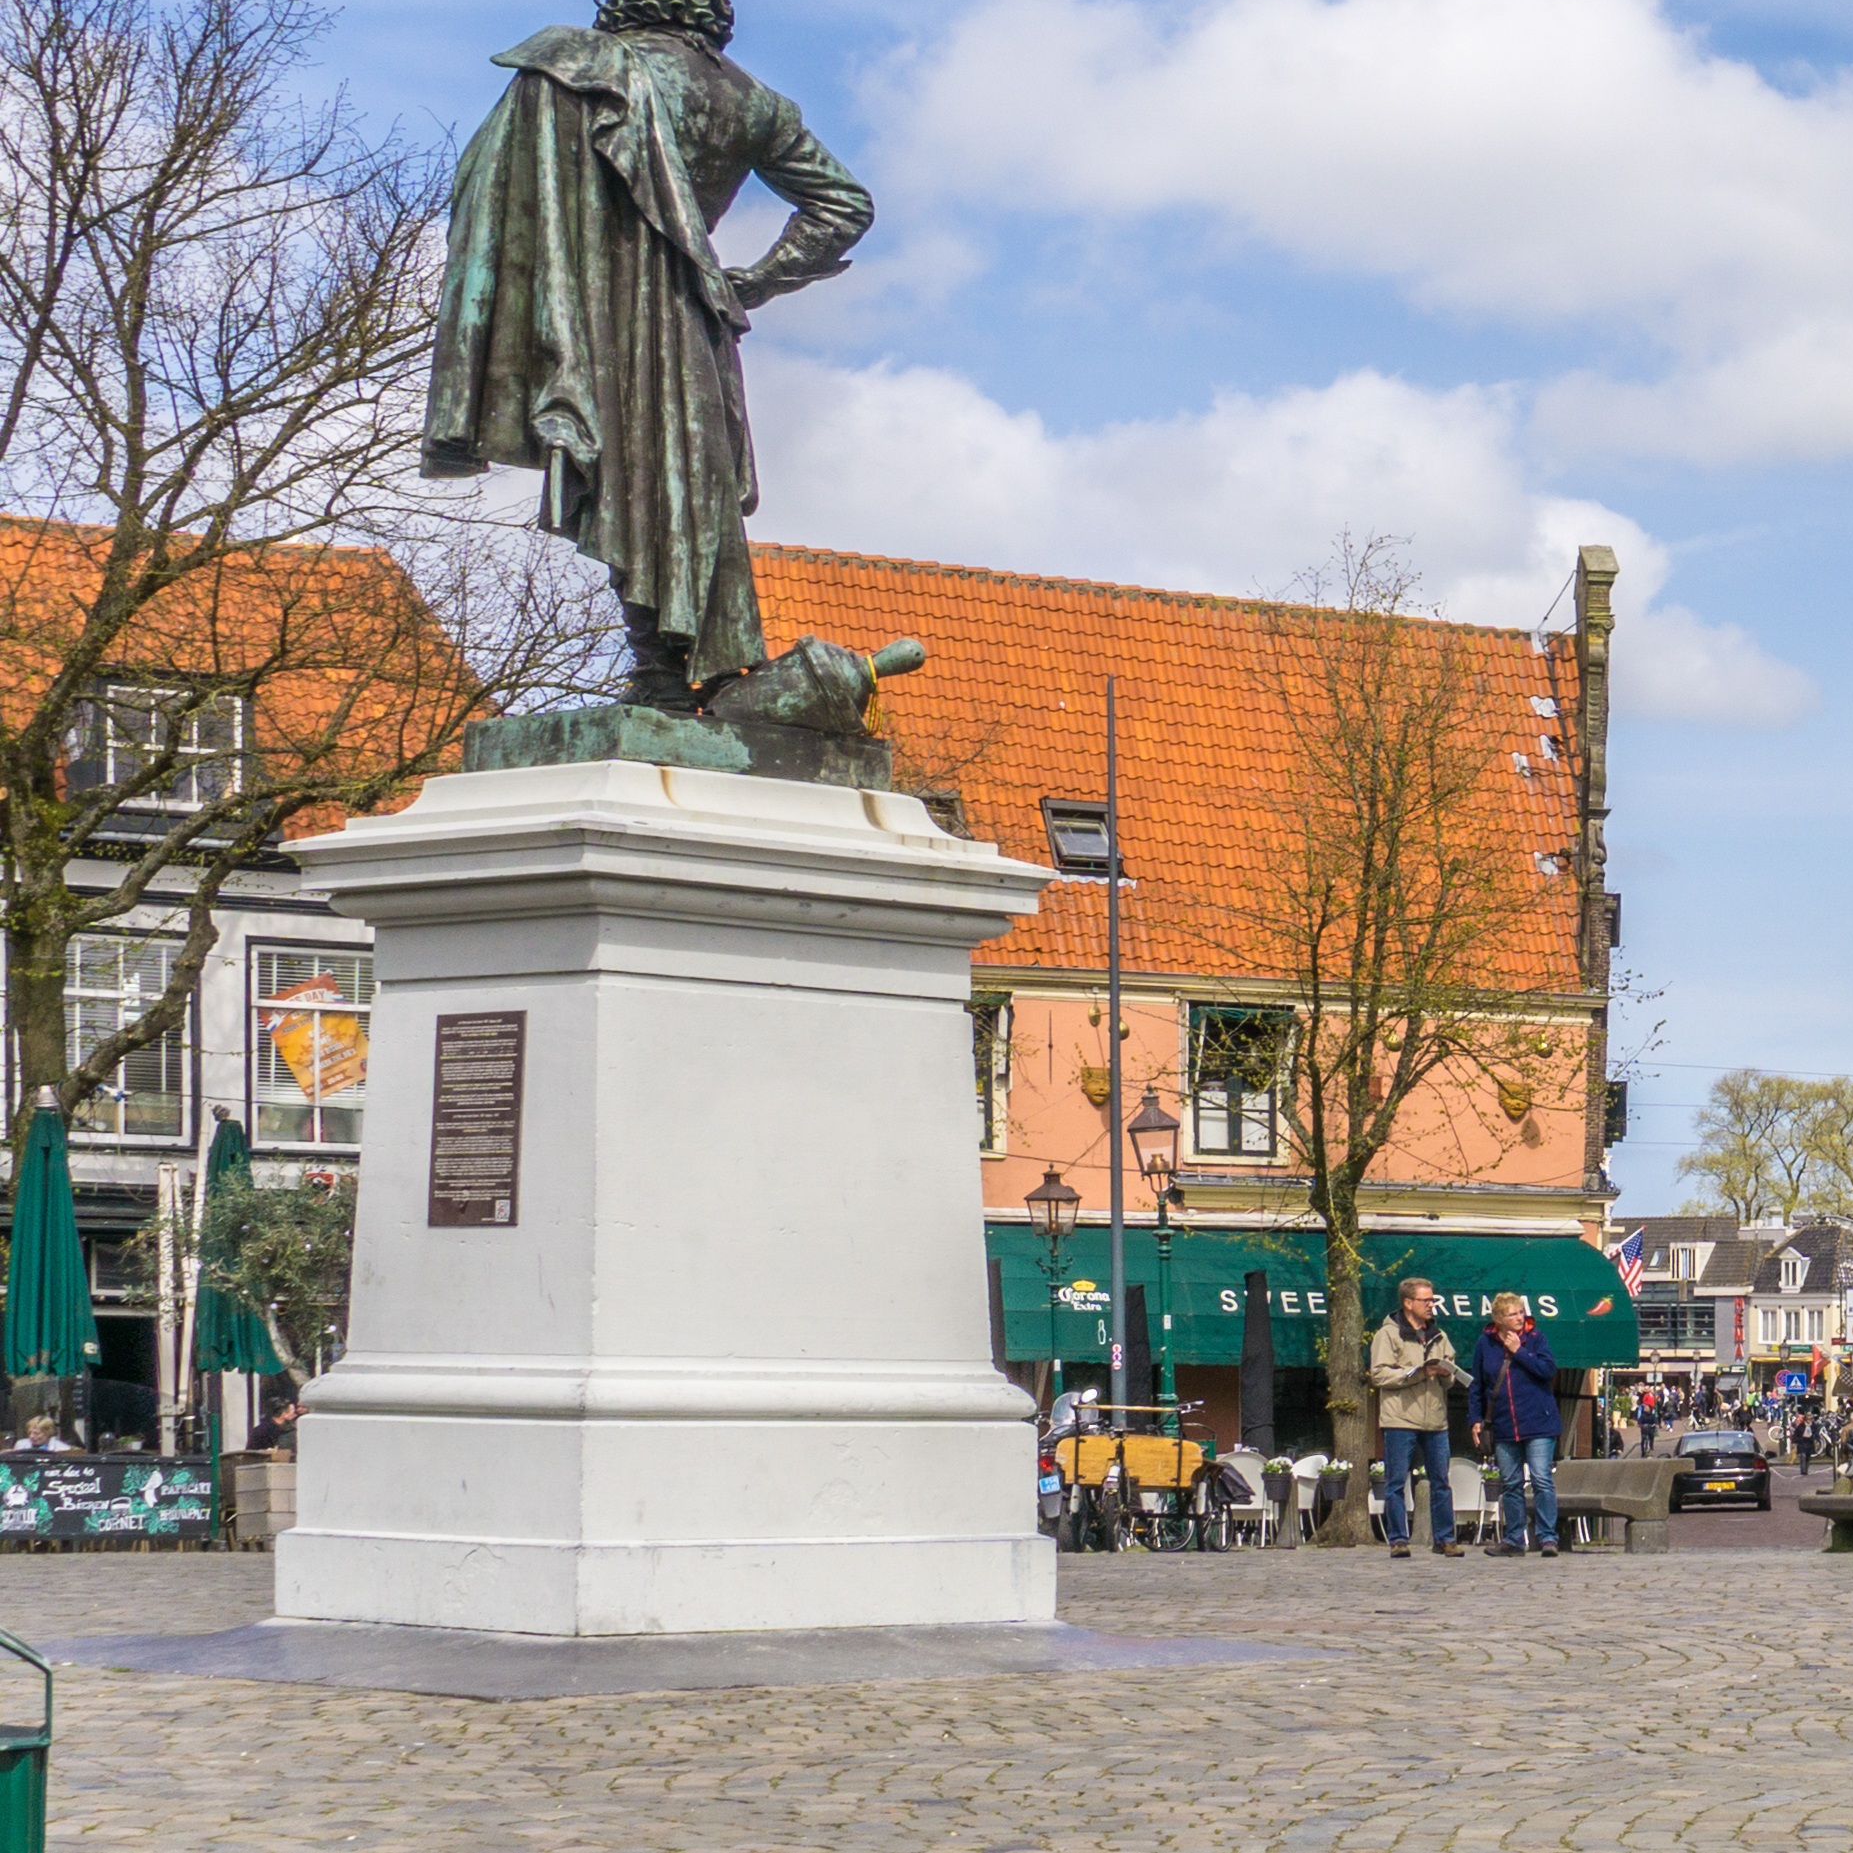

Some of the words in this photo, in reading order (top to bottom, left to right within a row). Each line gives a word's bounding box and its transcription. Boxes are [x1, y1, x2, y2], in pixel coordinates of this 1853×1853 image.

[1058, 1287, 1111, 1305] Corona
[1073, 1301, 1102, 1311] Extra
[1734, 1297, 1745, 1359] HEMA
[99, 1514, 146, 1532] CORNET
